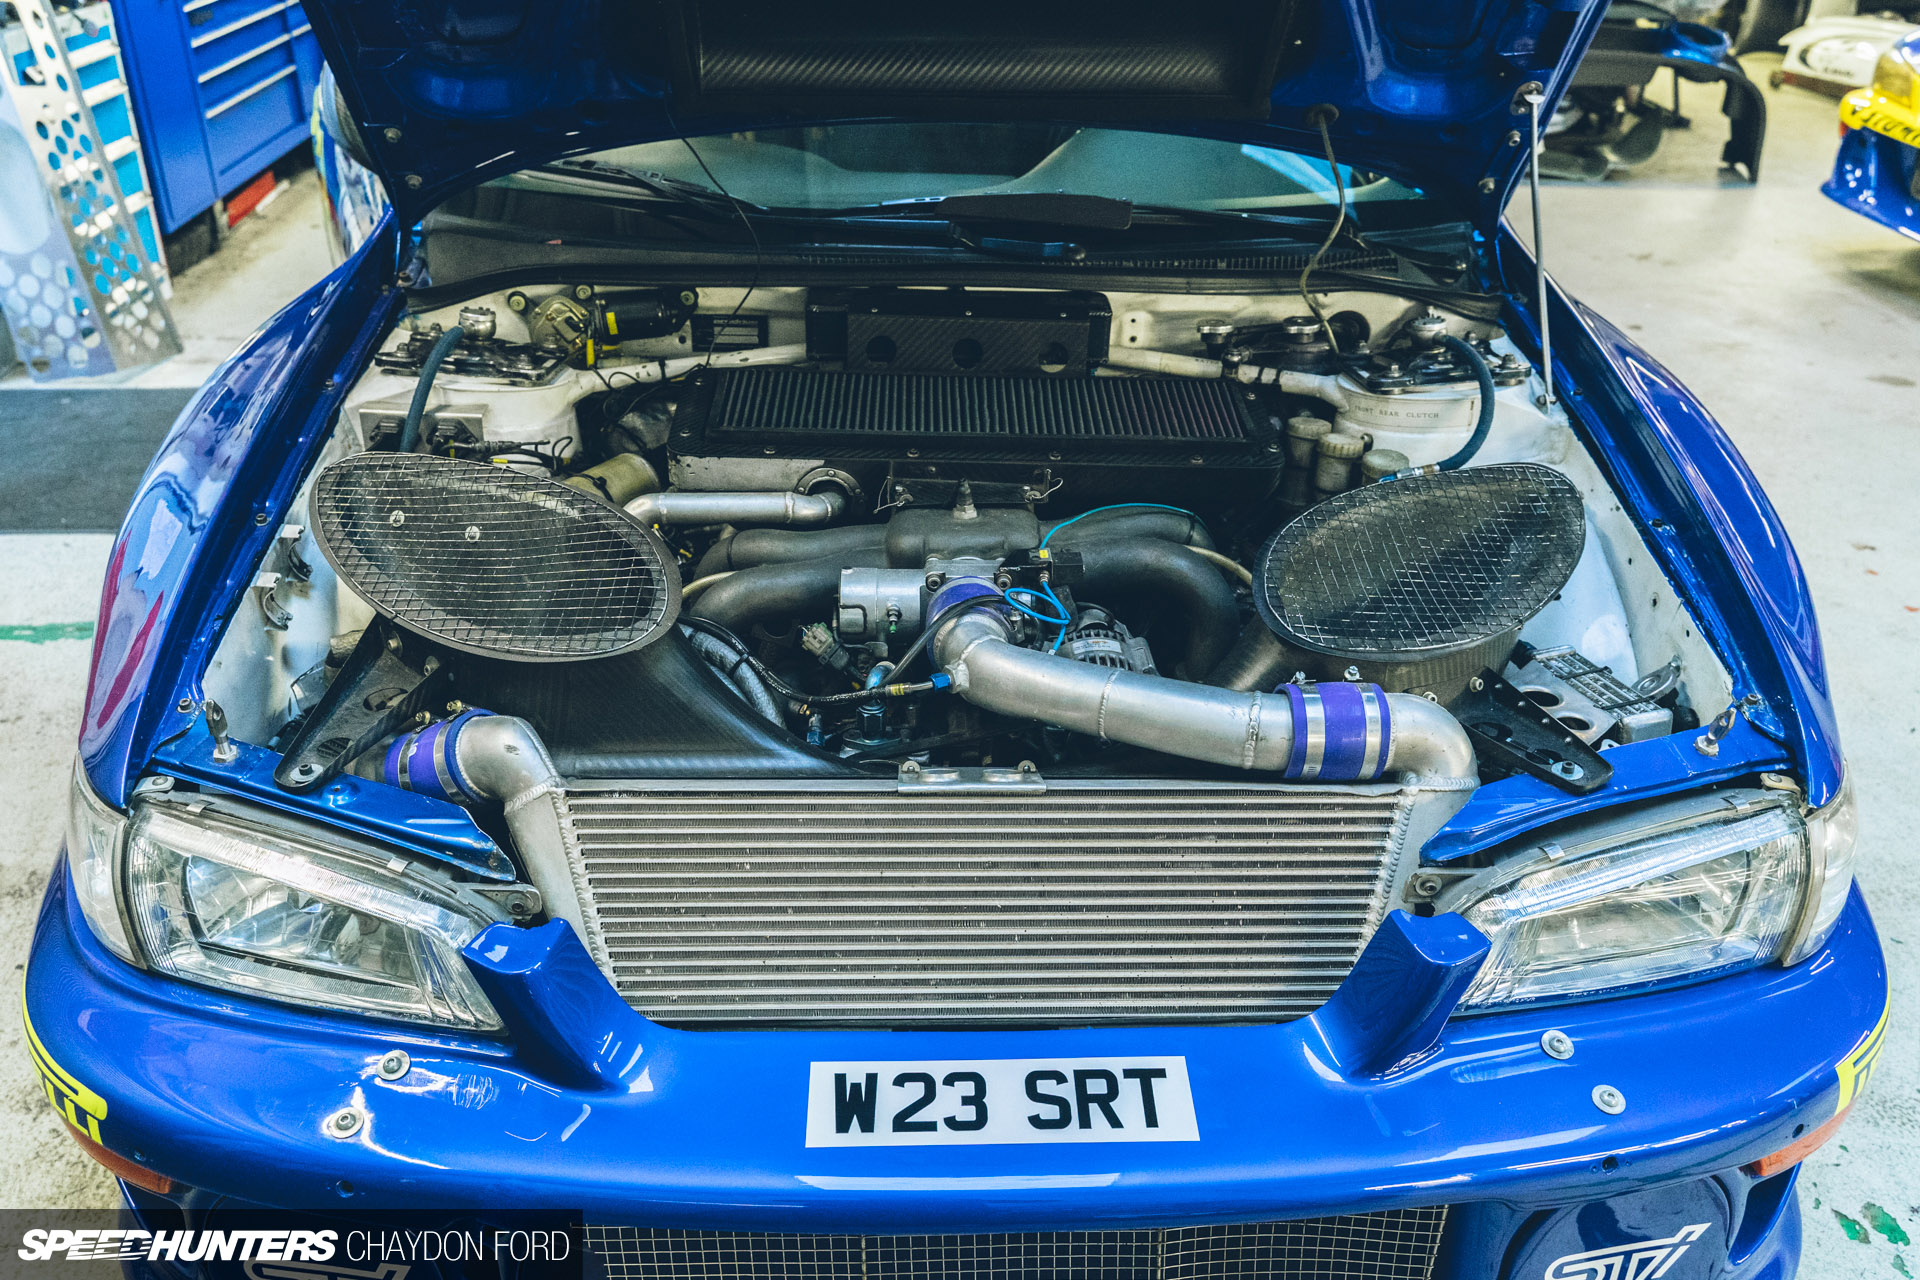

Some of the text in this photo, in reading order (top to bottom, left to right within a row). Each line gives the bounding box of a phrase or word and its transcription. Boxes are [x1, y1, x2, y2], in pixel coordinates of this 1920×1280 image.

[1379, 409, 1400, 418] REAR
[1406, 411, 1440, 419] CLUTCH
[834, 1067, 1167, 1133] W23 SRT
